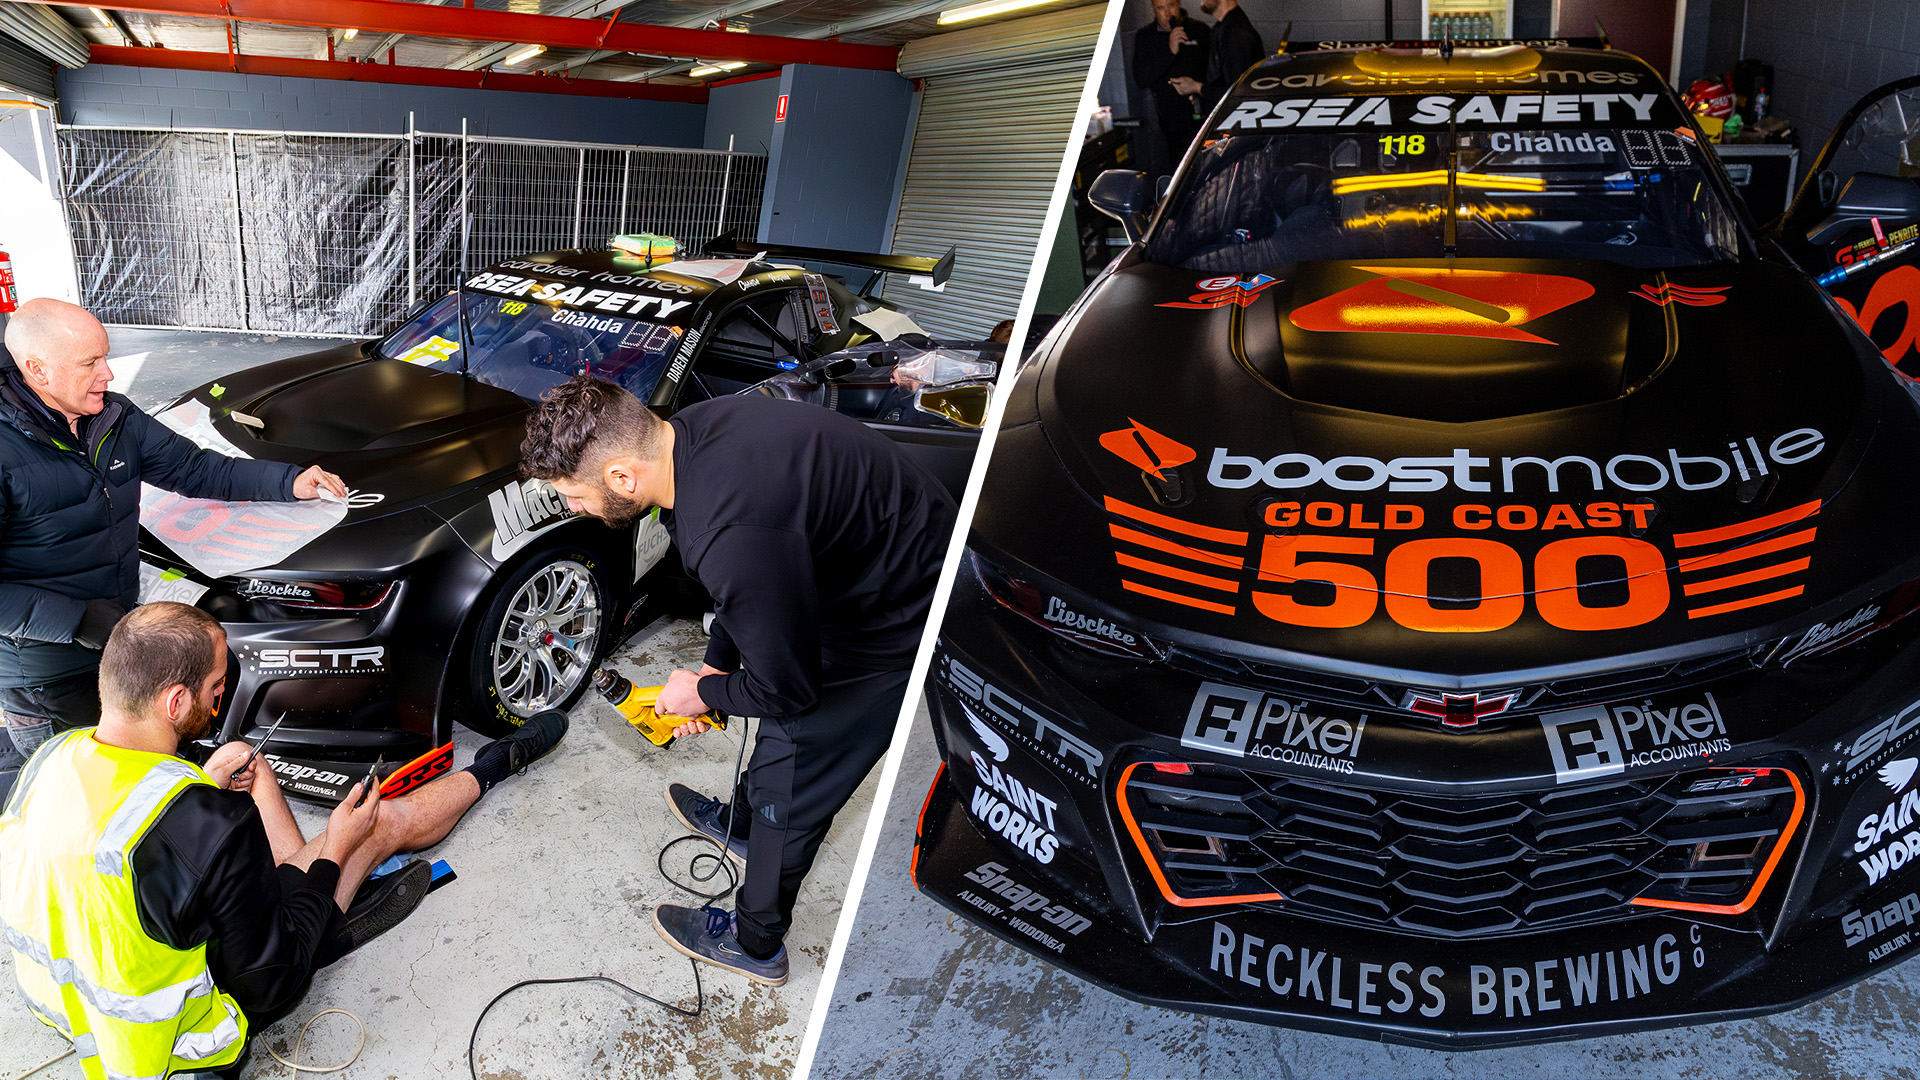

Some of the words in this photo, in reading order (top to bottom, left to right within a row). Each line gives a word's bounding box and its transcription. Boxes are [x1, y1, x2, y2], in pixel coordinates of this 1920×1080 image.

[1216, 97, 1393, 131] RSEA
[1408, 94, 1659, 124] SAFETY
[1378, 134, 1426, 155] 118
[1490, 131, 1616, 154] Chahda
[1888, 224, 1919, 245] PENRITE
[465, 272, 537, 297] RSEA
[532, 282, 693, 319] SAFETY
[500, 260, 591, 278] cavalier
[590, 270, 694, 295] homes
[499, 301, 528, 316] 118
[551, 309, 624, 334] Chahda
[666, 353, 689, 384] DAREN
[681, 328, 702, 360] MASON
[1263, 501, 1426, 530] GOLD
[1452, 502, 1655, 530] COAST
[245, 579, 312, 598] Lieschke
[1252, 534, 1671, 633] 500
[1044, 595, 1137, 646] Lieschke
[259, 646, 385, 668] SCTR
[949, 659, 1104, 779] SCTR
[1255, 697, 1369, 758] Pixel
[1612, 691, 1727, 751] Pixel
[1249, 743, 1355, 775] ACCOUNTANTS
[1630, 738, 1732, 767] ACCOUNTANTS
[294, 782, 337, 797] WODONGA
[970, 750, 1058, 832] SAINT
[970, 785, 1060, 864] WORKS
[963, 861, 1093, 936] Snap-on
[957, 889, 1004, 919] ALBURY
[1008, 916, 1067, 954] WODONGA
[1867, 931, 1912, 963] ALBURY
[1210, 921, 1446, 1018] RECKLESS
[1472, 932, 1681, 1018] BREWING
